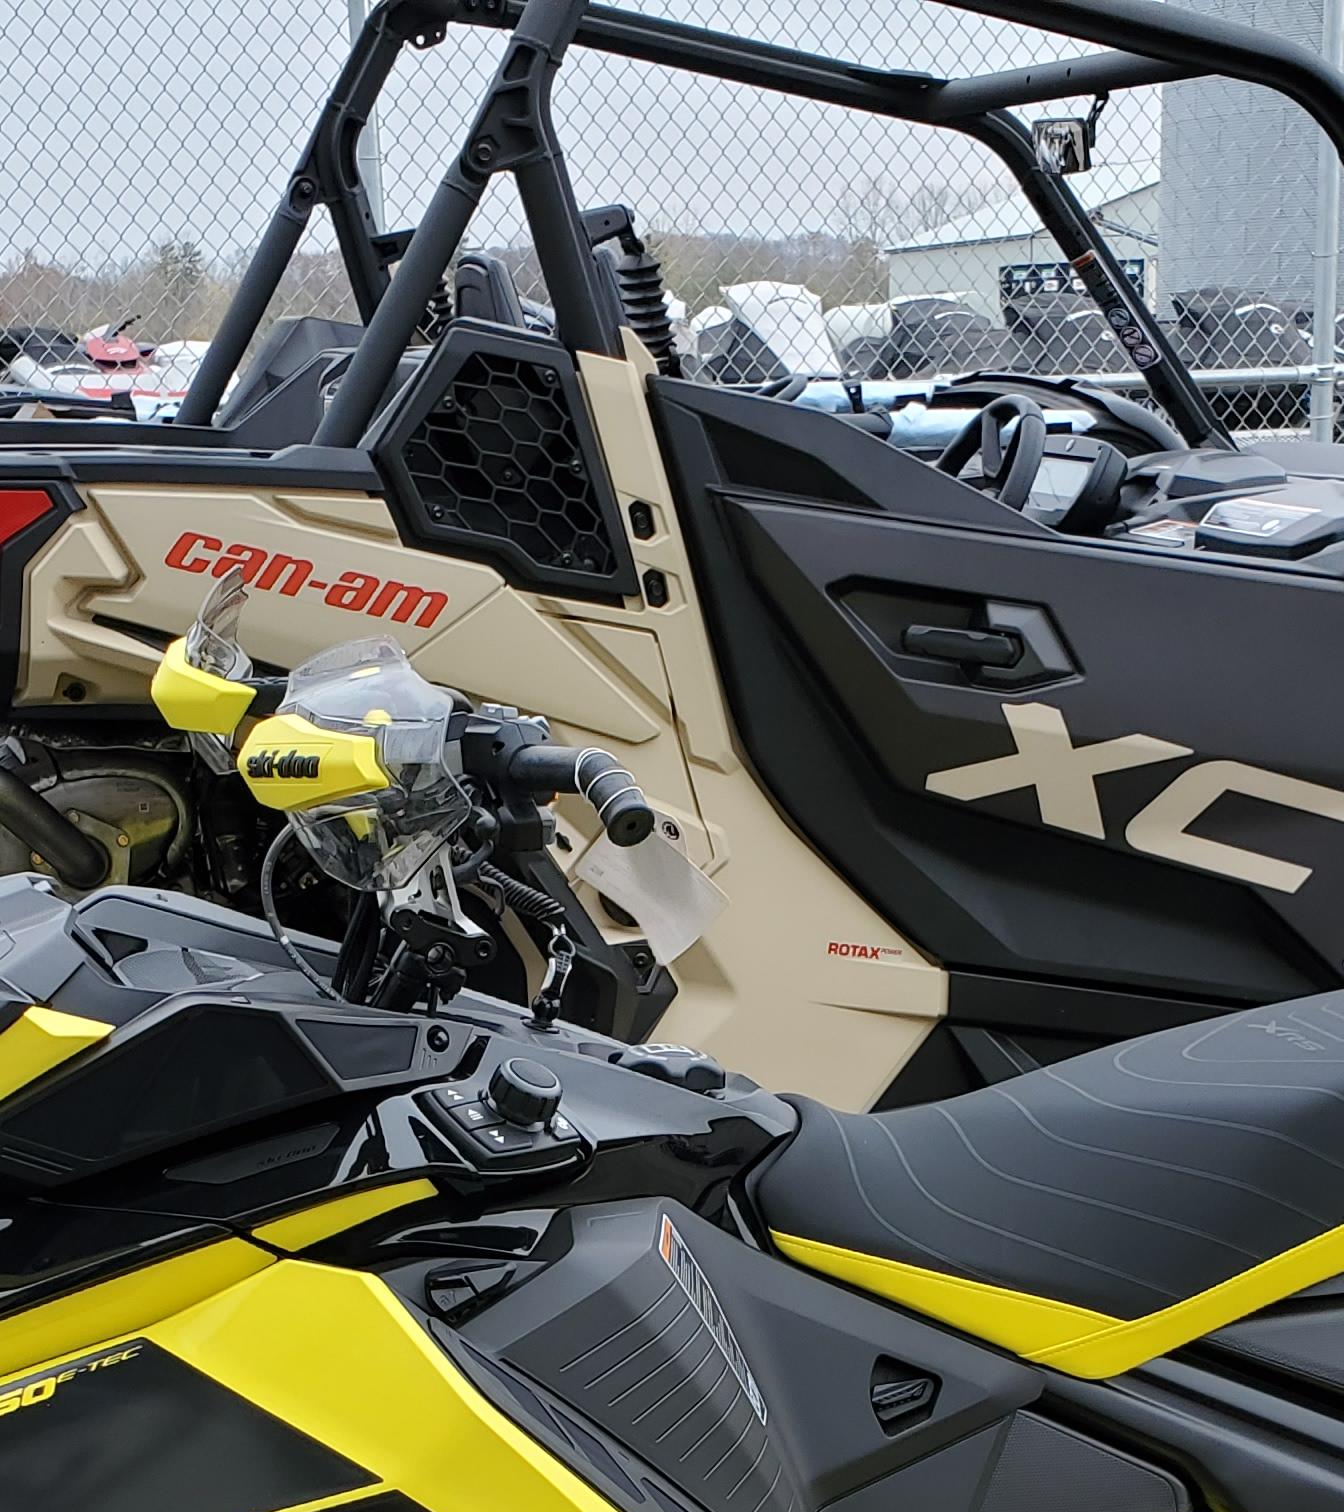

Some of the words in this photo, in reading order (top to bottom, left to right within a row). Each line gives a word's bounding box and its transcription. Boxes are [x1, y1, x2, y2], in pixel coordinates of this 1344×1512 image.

[247, 749, 321, 779] ski-doo
[827, 942, 881, 960] ROTAX
[57, 1345, 143, 1384] E-TEC
